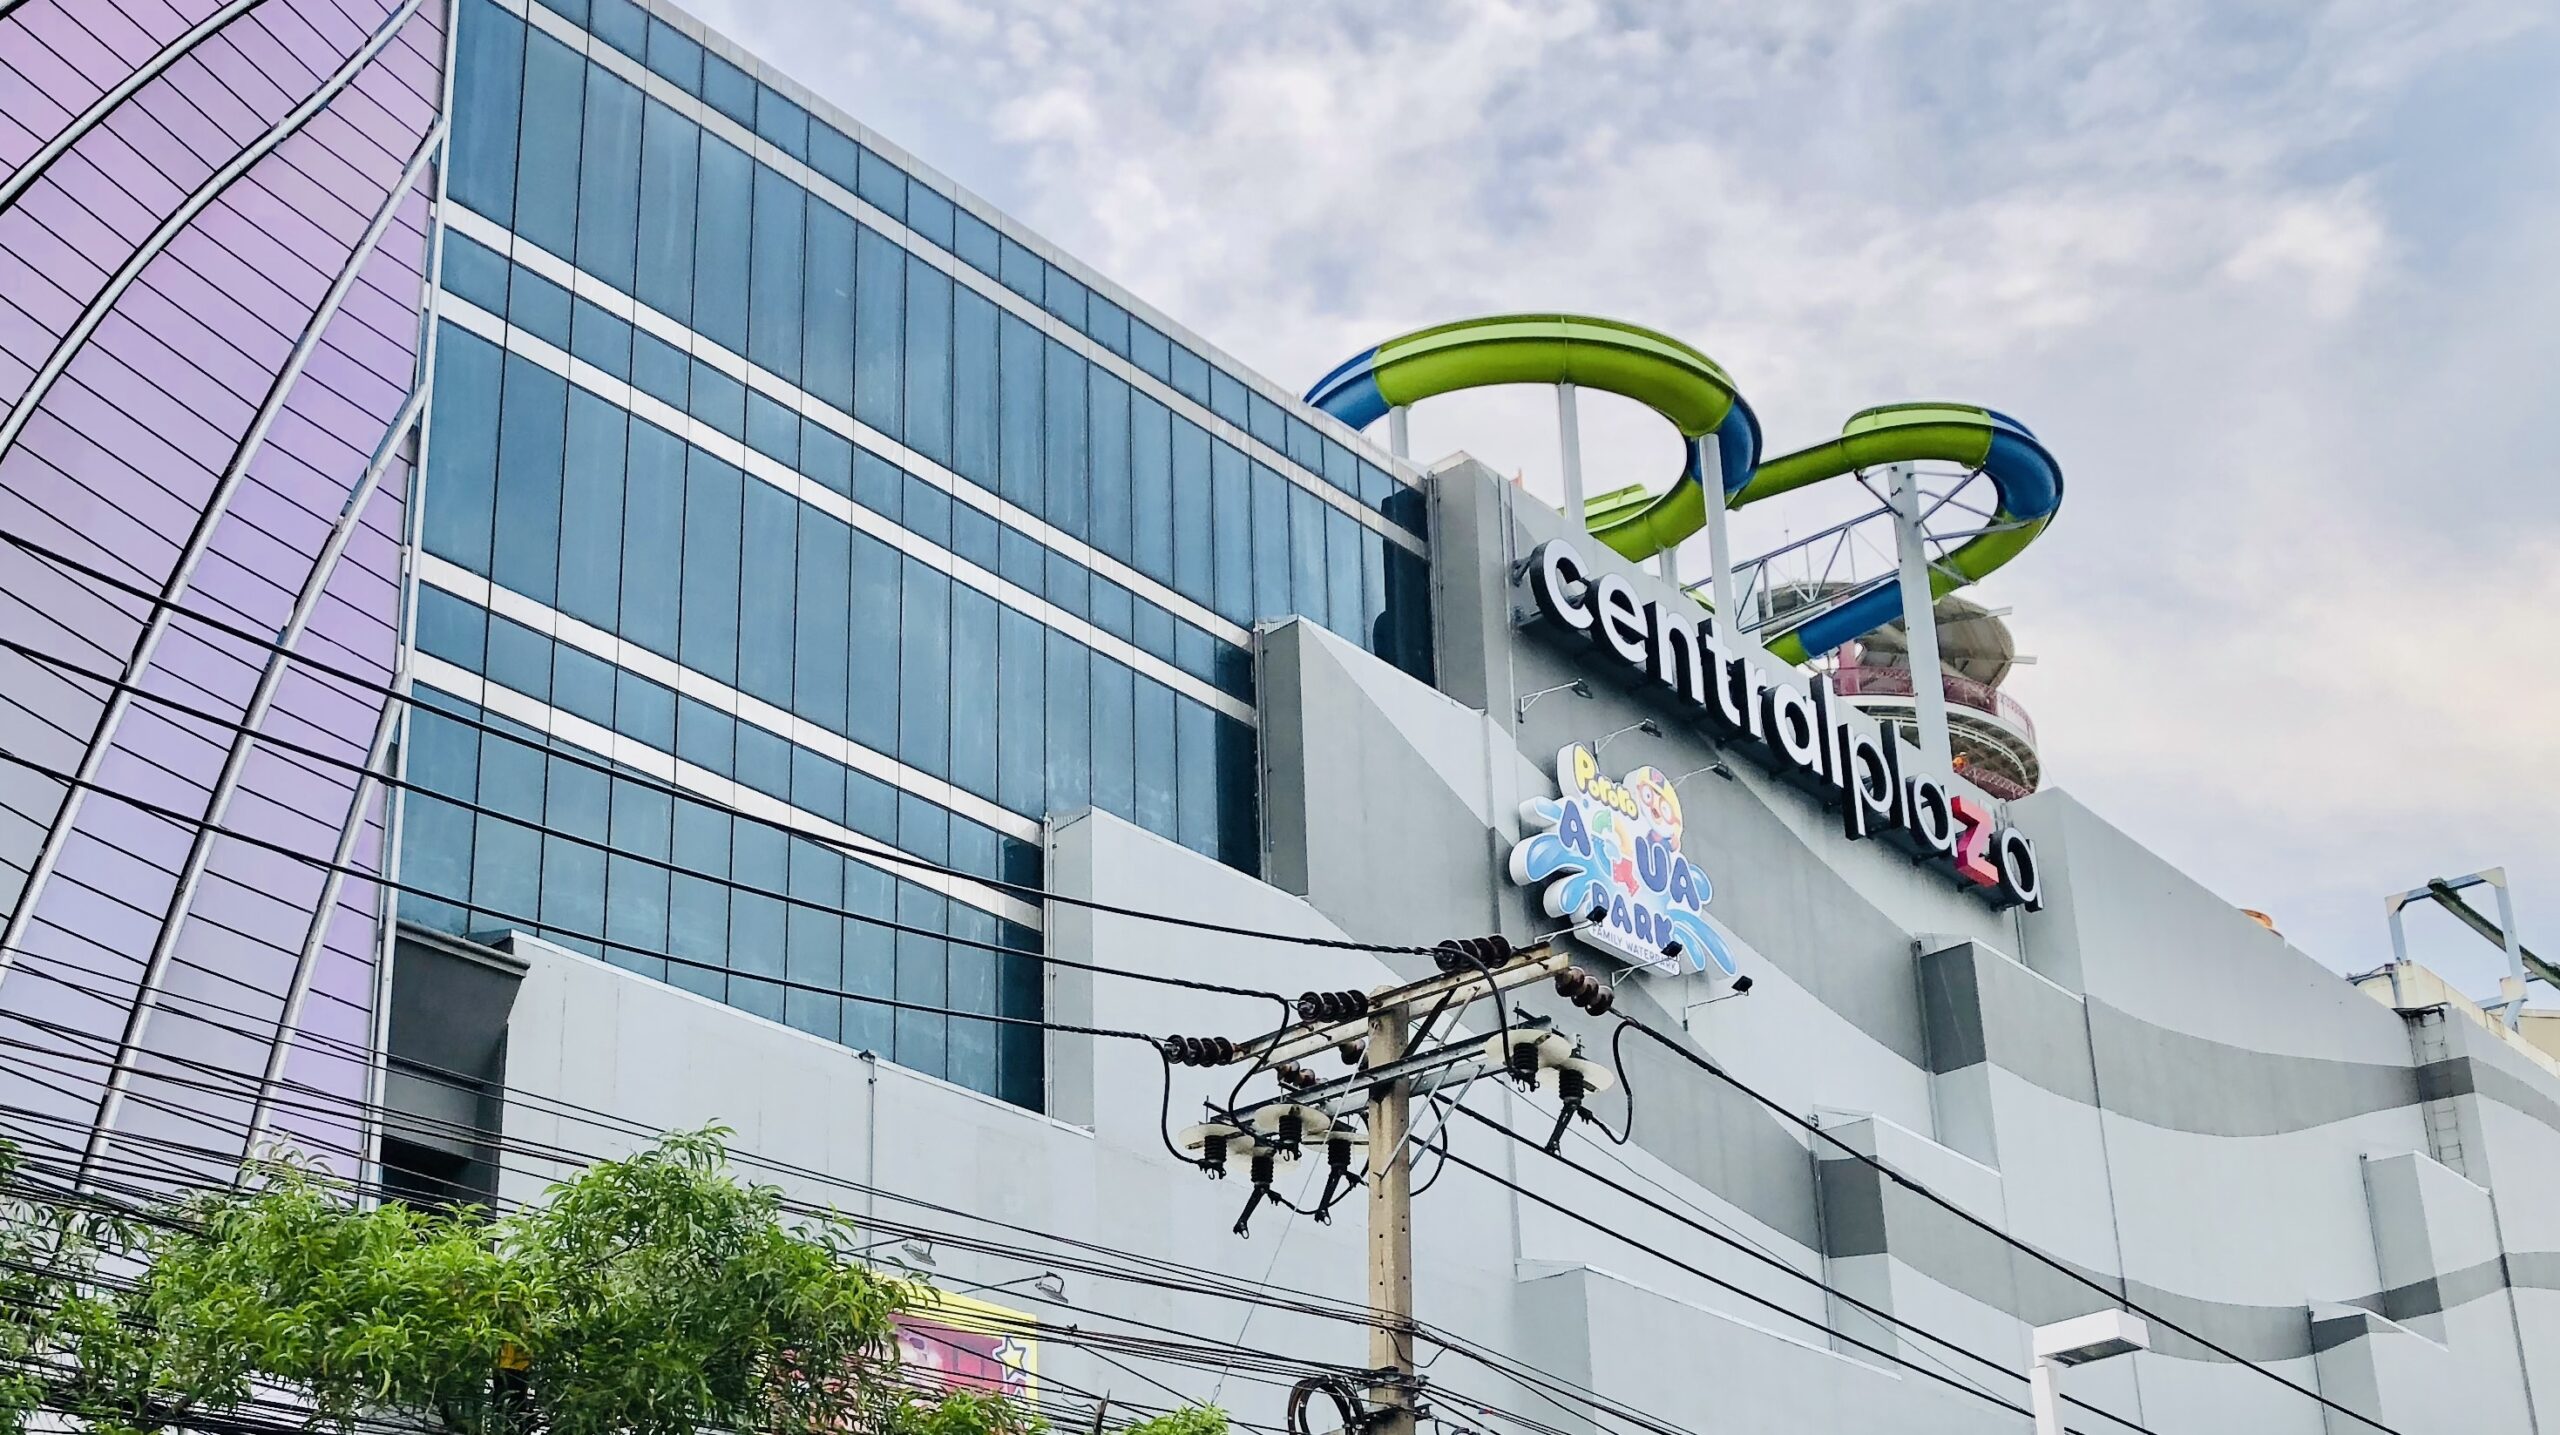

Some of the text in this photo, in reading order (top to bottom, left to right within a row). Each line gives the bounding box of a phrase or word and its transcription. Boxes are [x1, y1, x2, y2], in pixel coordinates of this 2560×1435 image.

[1531, 538, 2042, 911] centralplaza
[1573, 743, 1639, 820] Pororo
[1592, 882, 1673, 949] PARK
[1592, 926, 1623, 945] FAMILY
